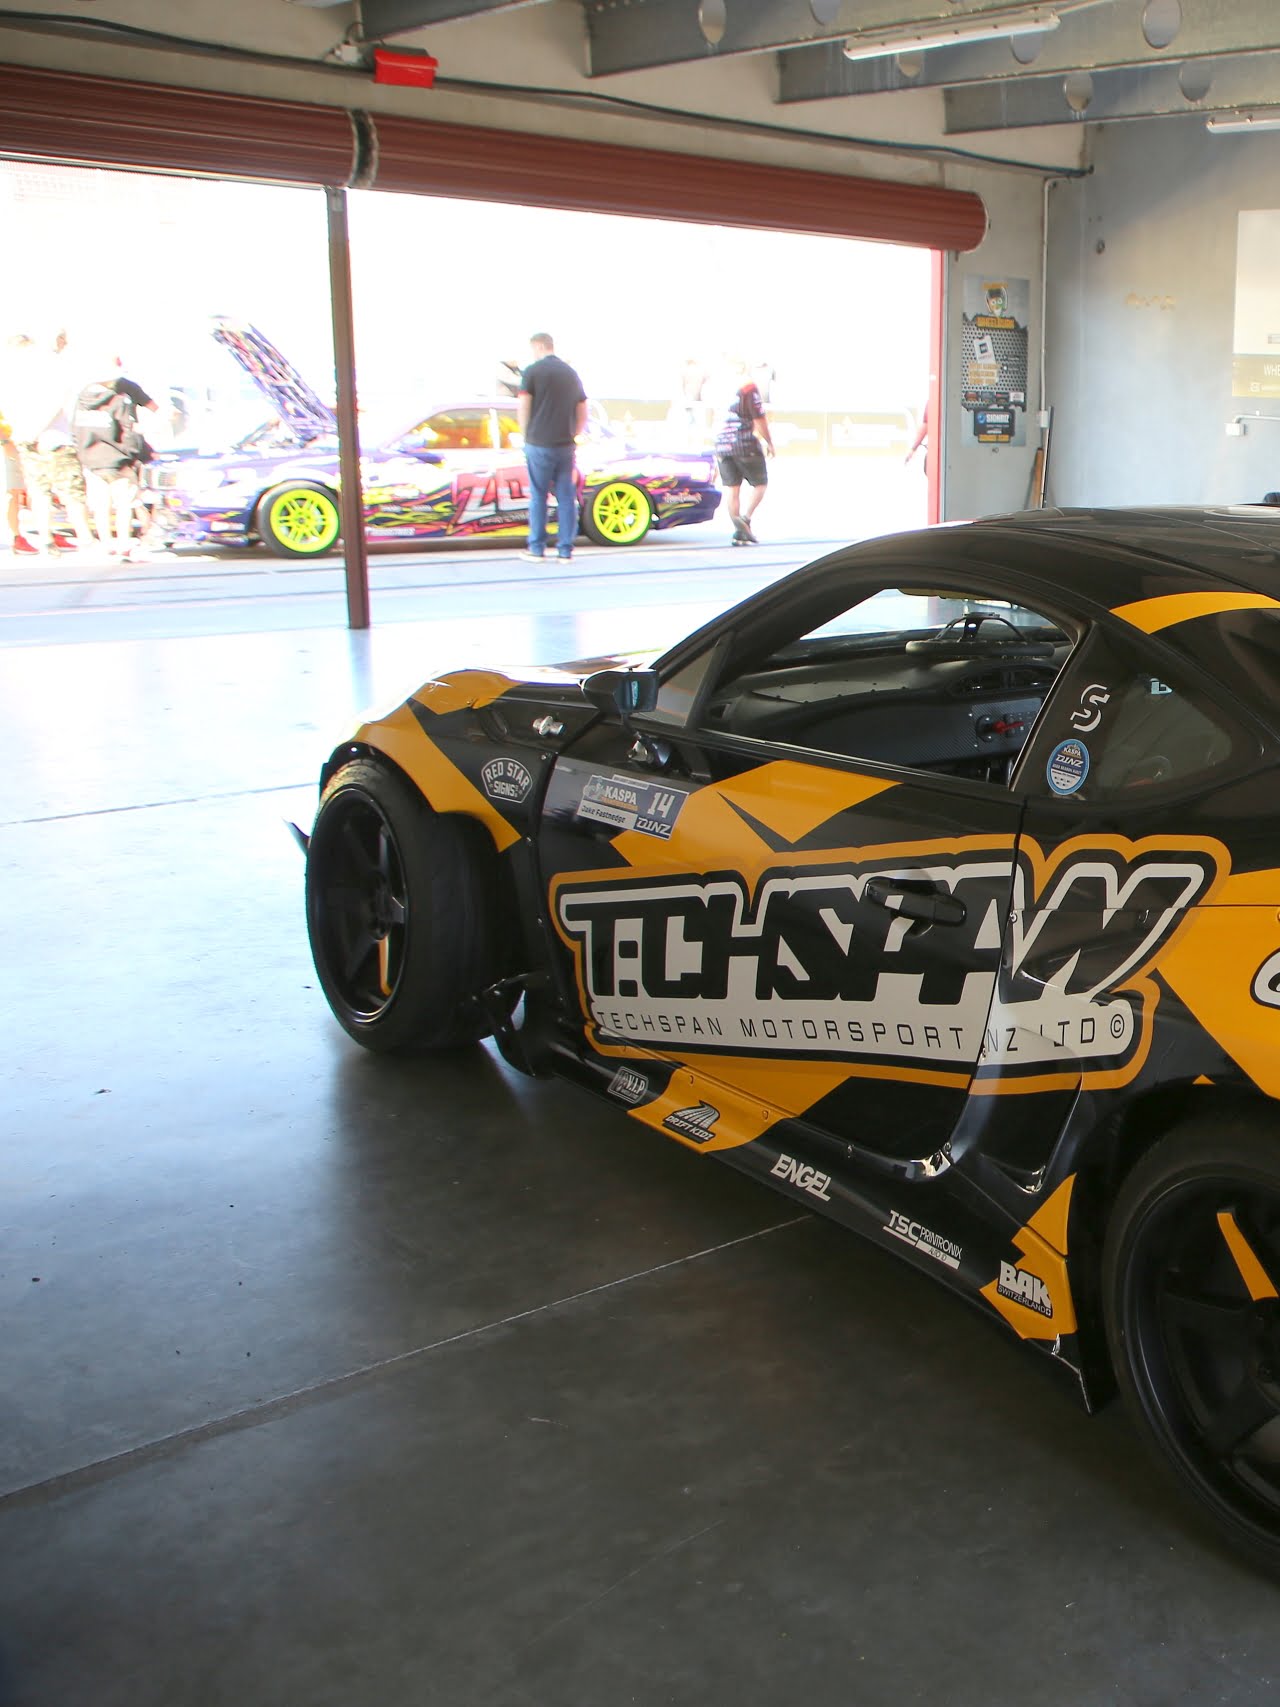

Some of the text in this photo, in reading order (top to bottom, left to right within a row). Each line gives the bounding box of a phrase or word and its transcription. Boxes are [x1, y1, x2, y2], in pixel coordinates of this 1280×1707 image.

[484, 761, 530, 790] RED STAR
[493, 780, 516, 797] SIGNS
[604, 785, 637, 805] KASPA
[647, 792, 676, 819] 14
[581, 805, 595, 816] Jake
[597, 1011, 723, 1036] TECHSPAN
[740, 1017, 964, 1049] MOTORSPORT
[987, 1027, 1018, 1052] NZ
[1040, 1018, 1096, 1047] LTD
[665, 1115, 715, 1141] DRIFT KIDZ
[770, 1153, 832, 1202] ENGEL
[888, 1209, 963, 1260] TSC PRINTRONIX
[998, 1284, 1046, 1314] SWITZERLAND
[1000, 1260, 1052, 1309] BAK
